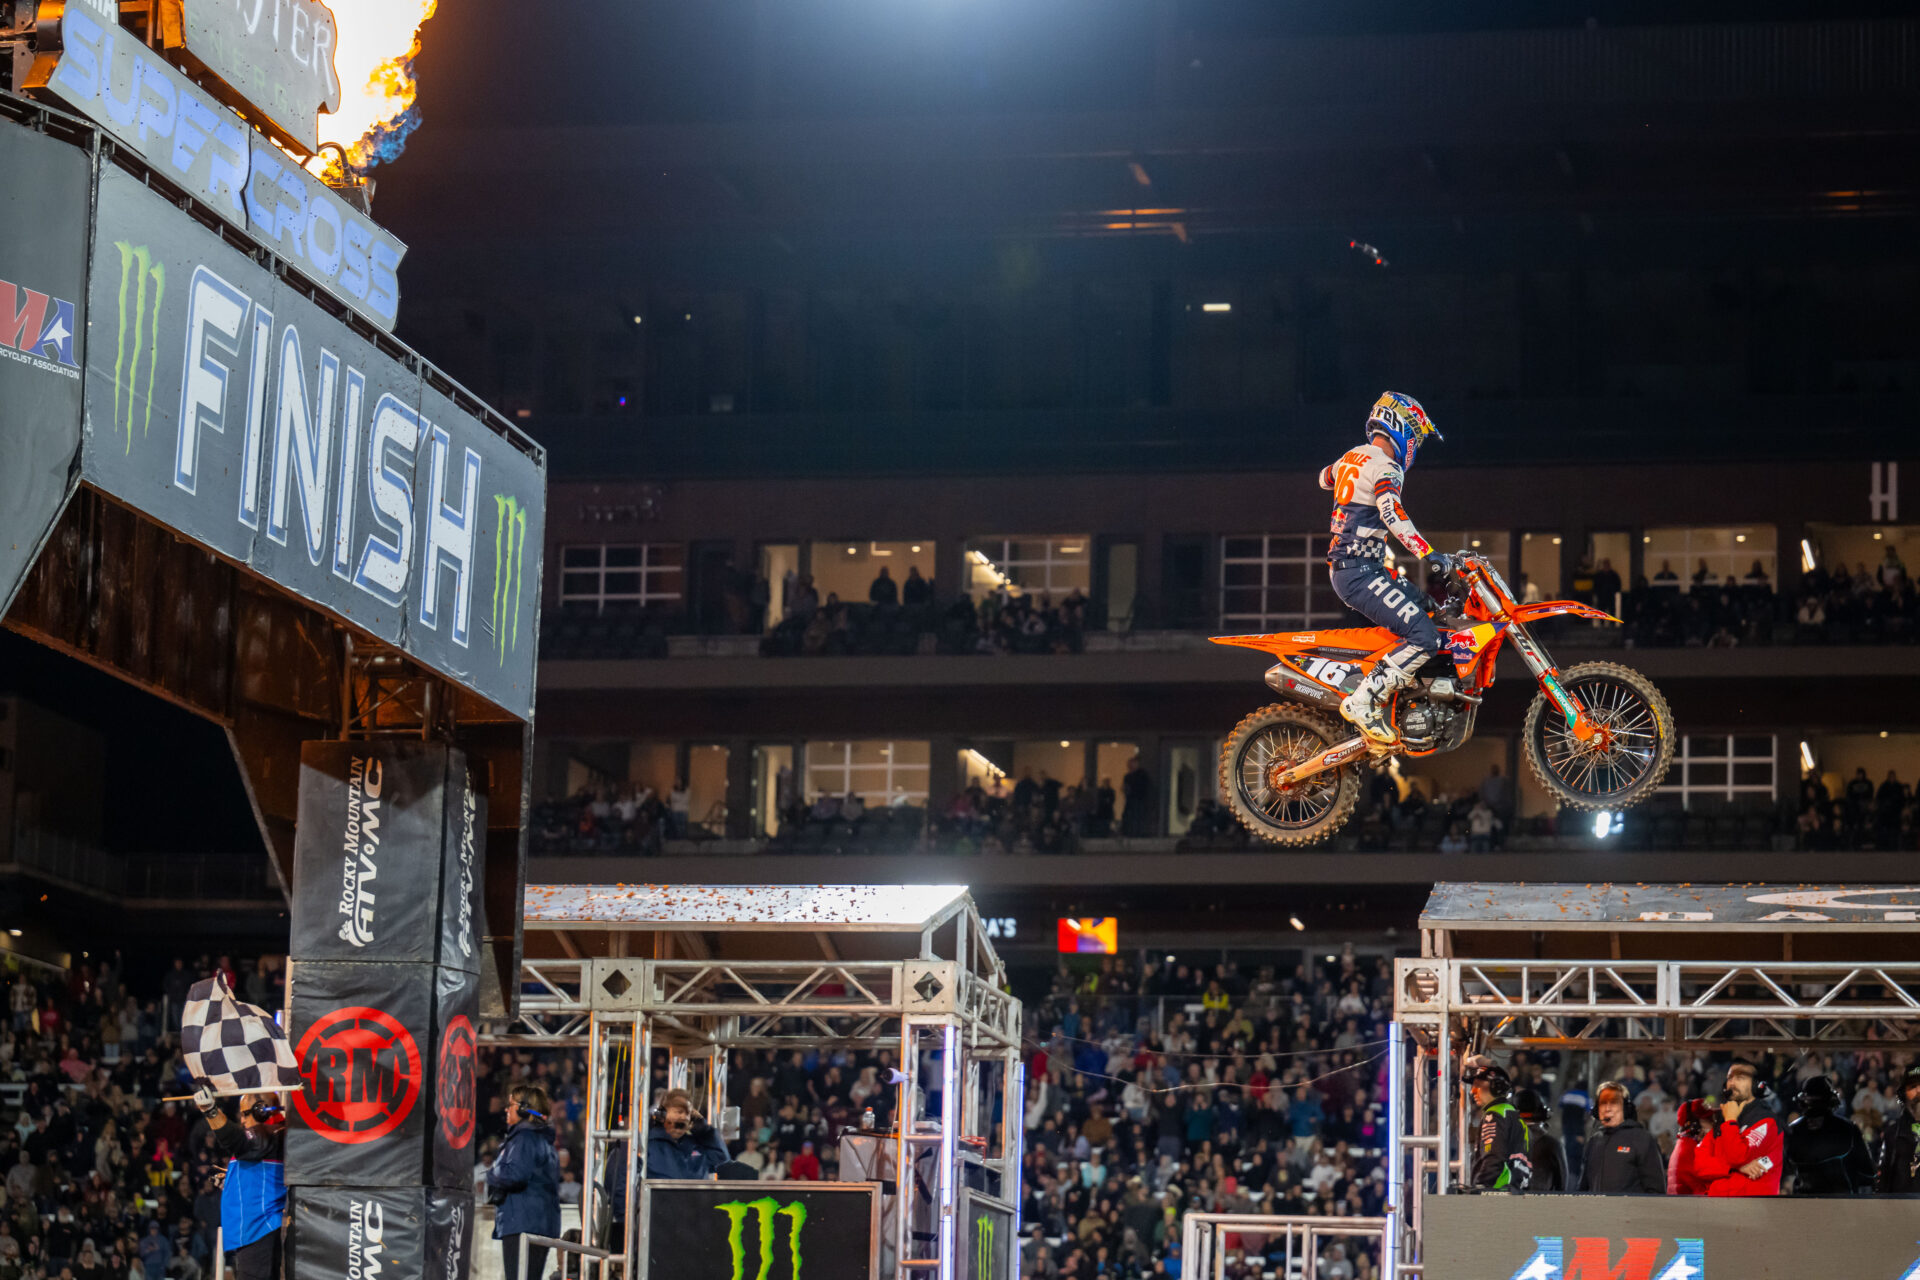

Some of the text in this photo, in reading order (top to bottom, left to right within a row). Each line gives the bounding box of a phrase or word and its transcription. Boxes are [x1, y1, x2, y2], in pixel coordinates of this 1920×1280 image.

[58, 8, 400, 321] SUPERCROSS
[32, 359, 80, 380] ASSOCIATION
[174, 264, 482, 649] FINISH
[1334, 465, 1359, 505] 16
[1382, 498, 1397, 526] THOR
[1305, 657, 1351, 690] 16
[1552, 687, 1576, 717] MOTOREX
[339, 756, 364, 916] ROCKY MOUNTAIN
[315, 1048, 402, 1103] RM
[346, 1200, 363, 1280] OUNTAIN
[1509, 1236, 1705, 1280] AMA
